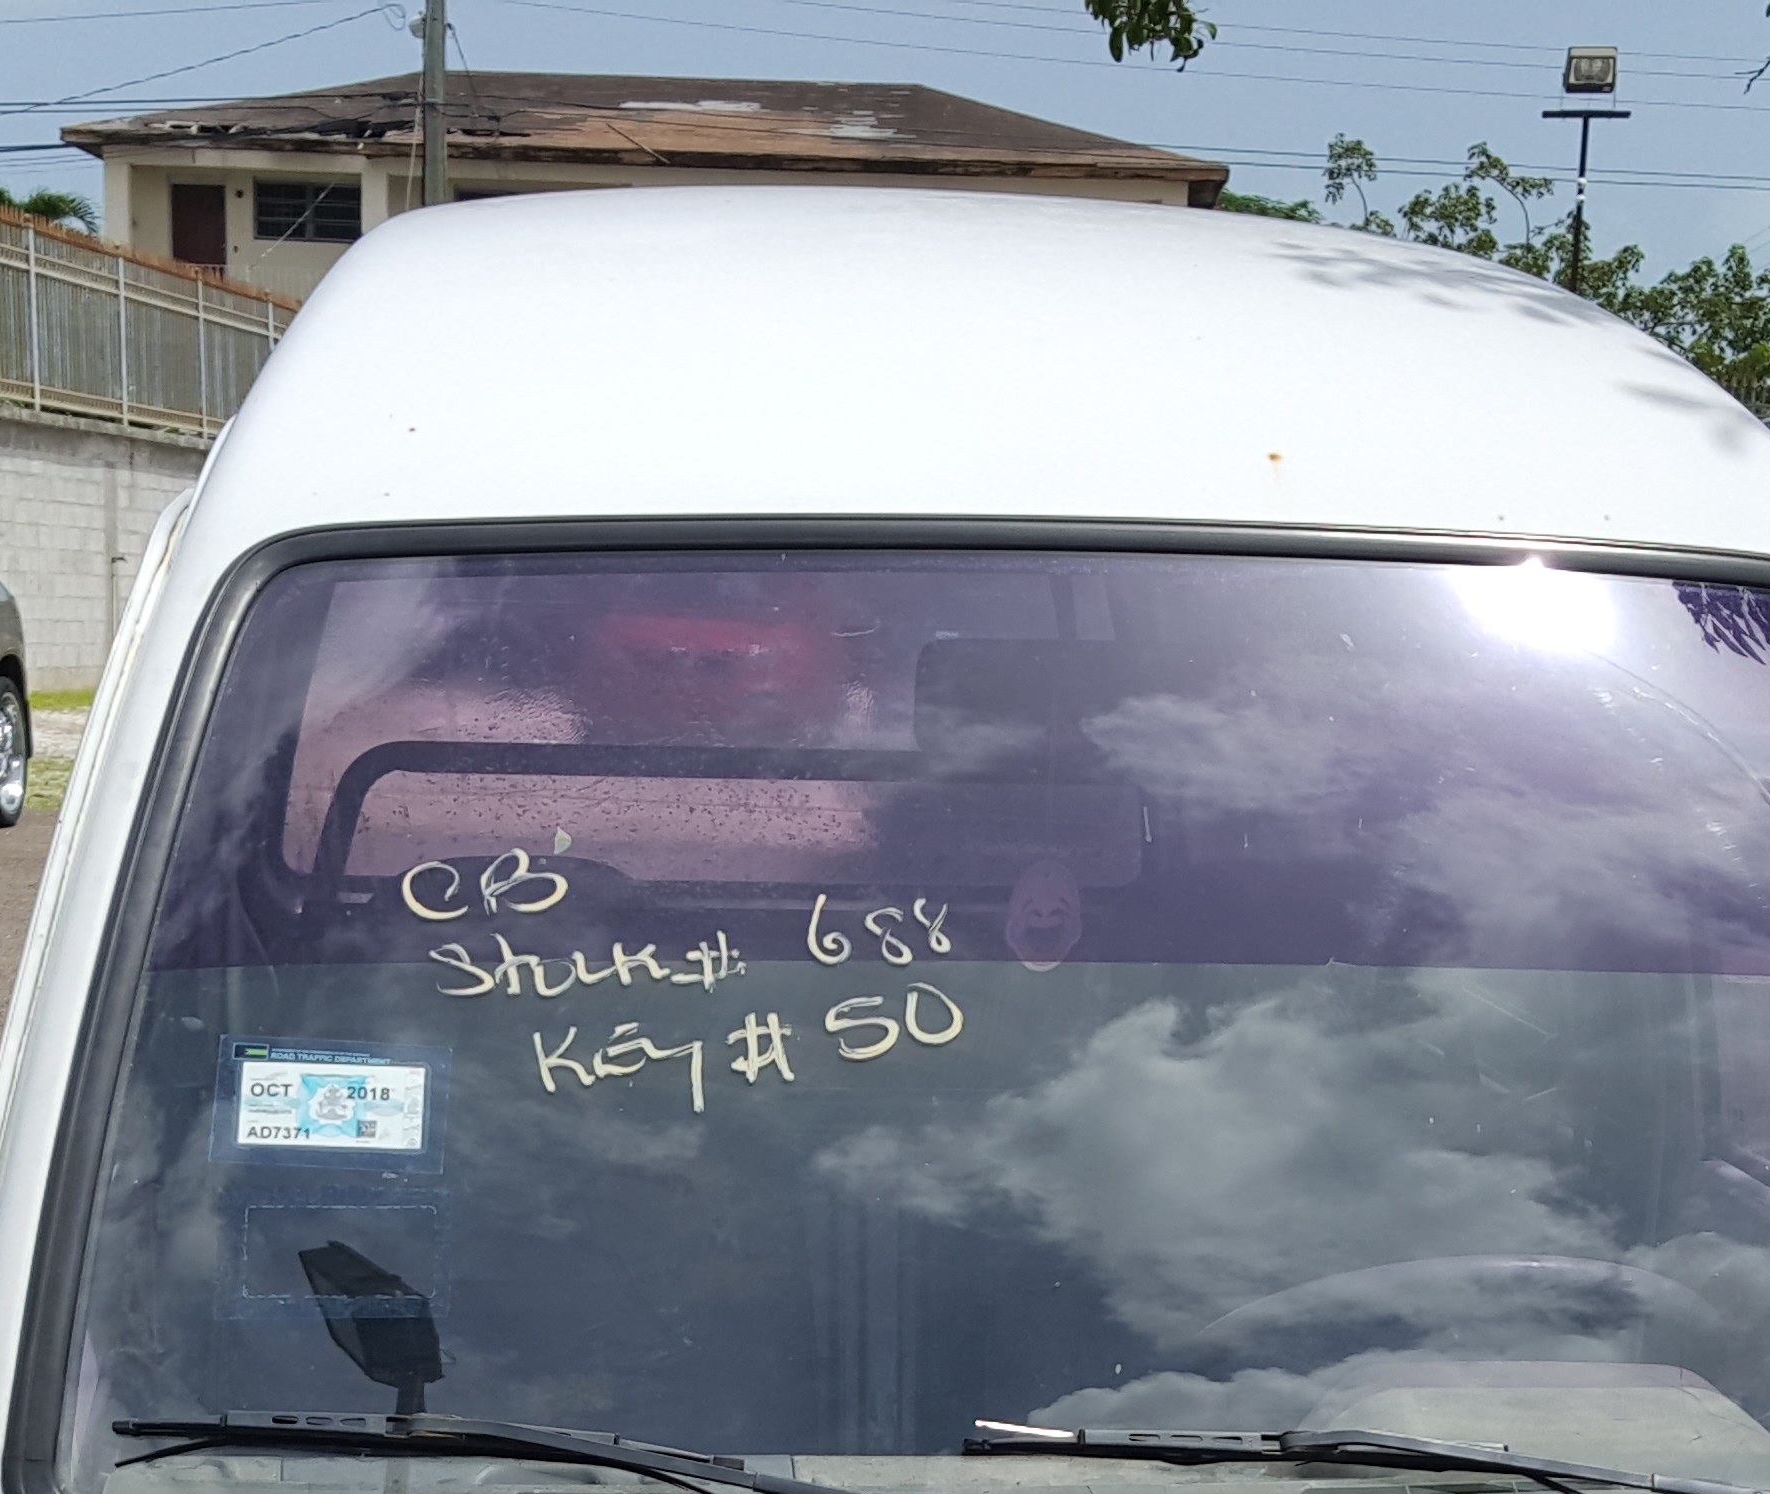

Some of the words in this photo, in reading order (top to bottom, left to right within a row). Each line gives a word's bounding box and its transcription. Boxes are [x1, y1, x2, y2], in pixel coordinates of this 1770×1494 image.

[805, 892, 952, 967] 688
[726, 1010, 796, 1083] #
[823, 981, 966, 1062] 50
[270, 1051, 296, 1061] ROAD
[297, 1053, 334, 1063] TRAFFIC
[334, 1055, 392, 1066] DEPARTMENT
[250, 1082, 294, 1098] OCT
[346, 1086, 391, 1101] 2018
[246, 1125, 311, 1140] AD7371
